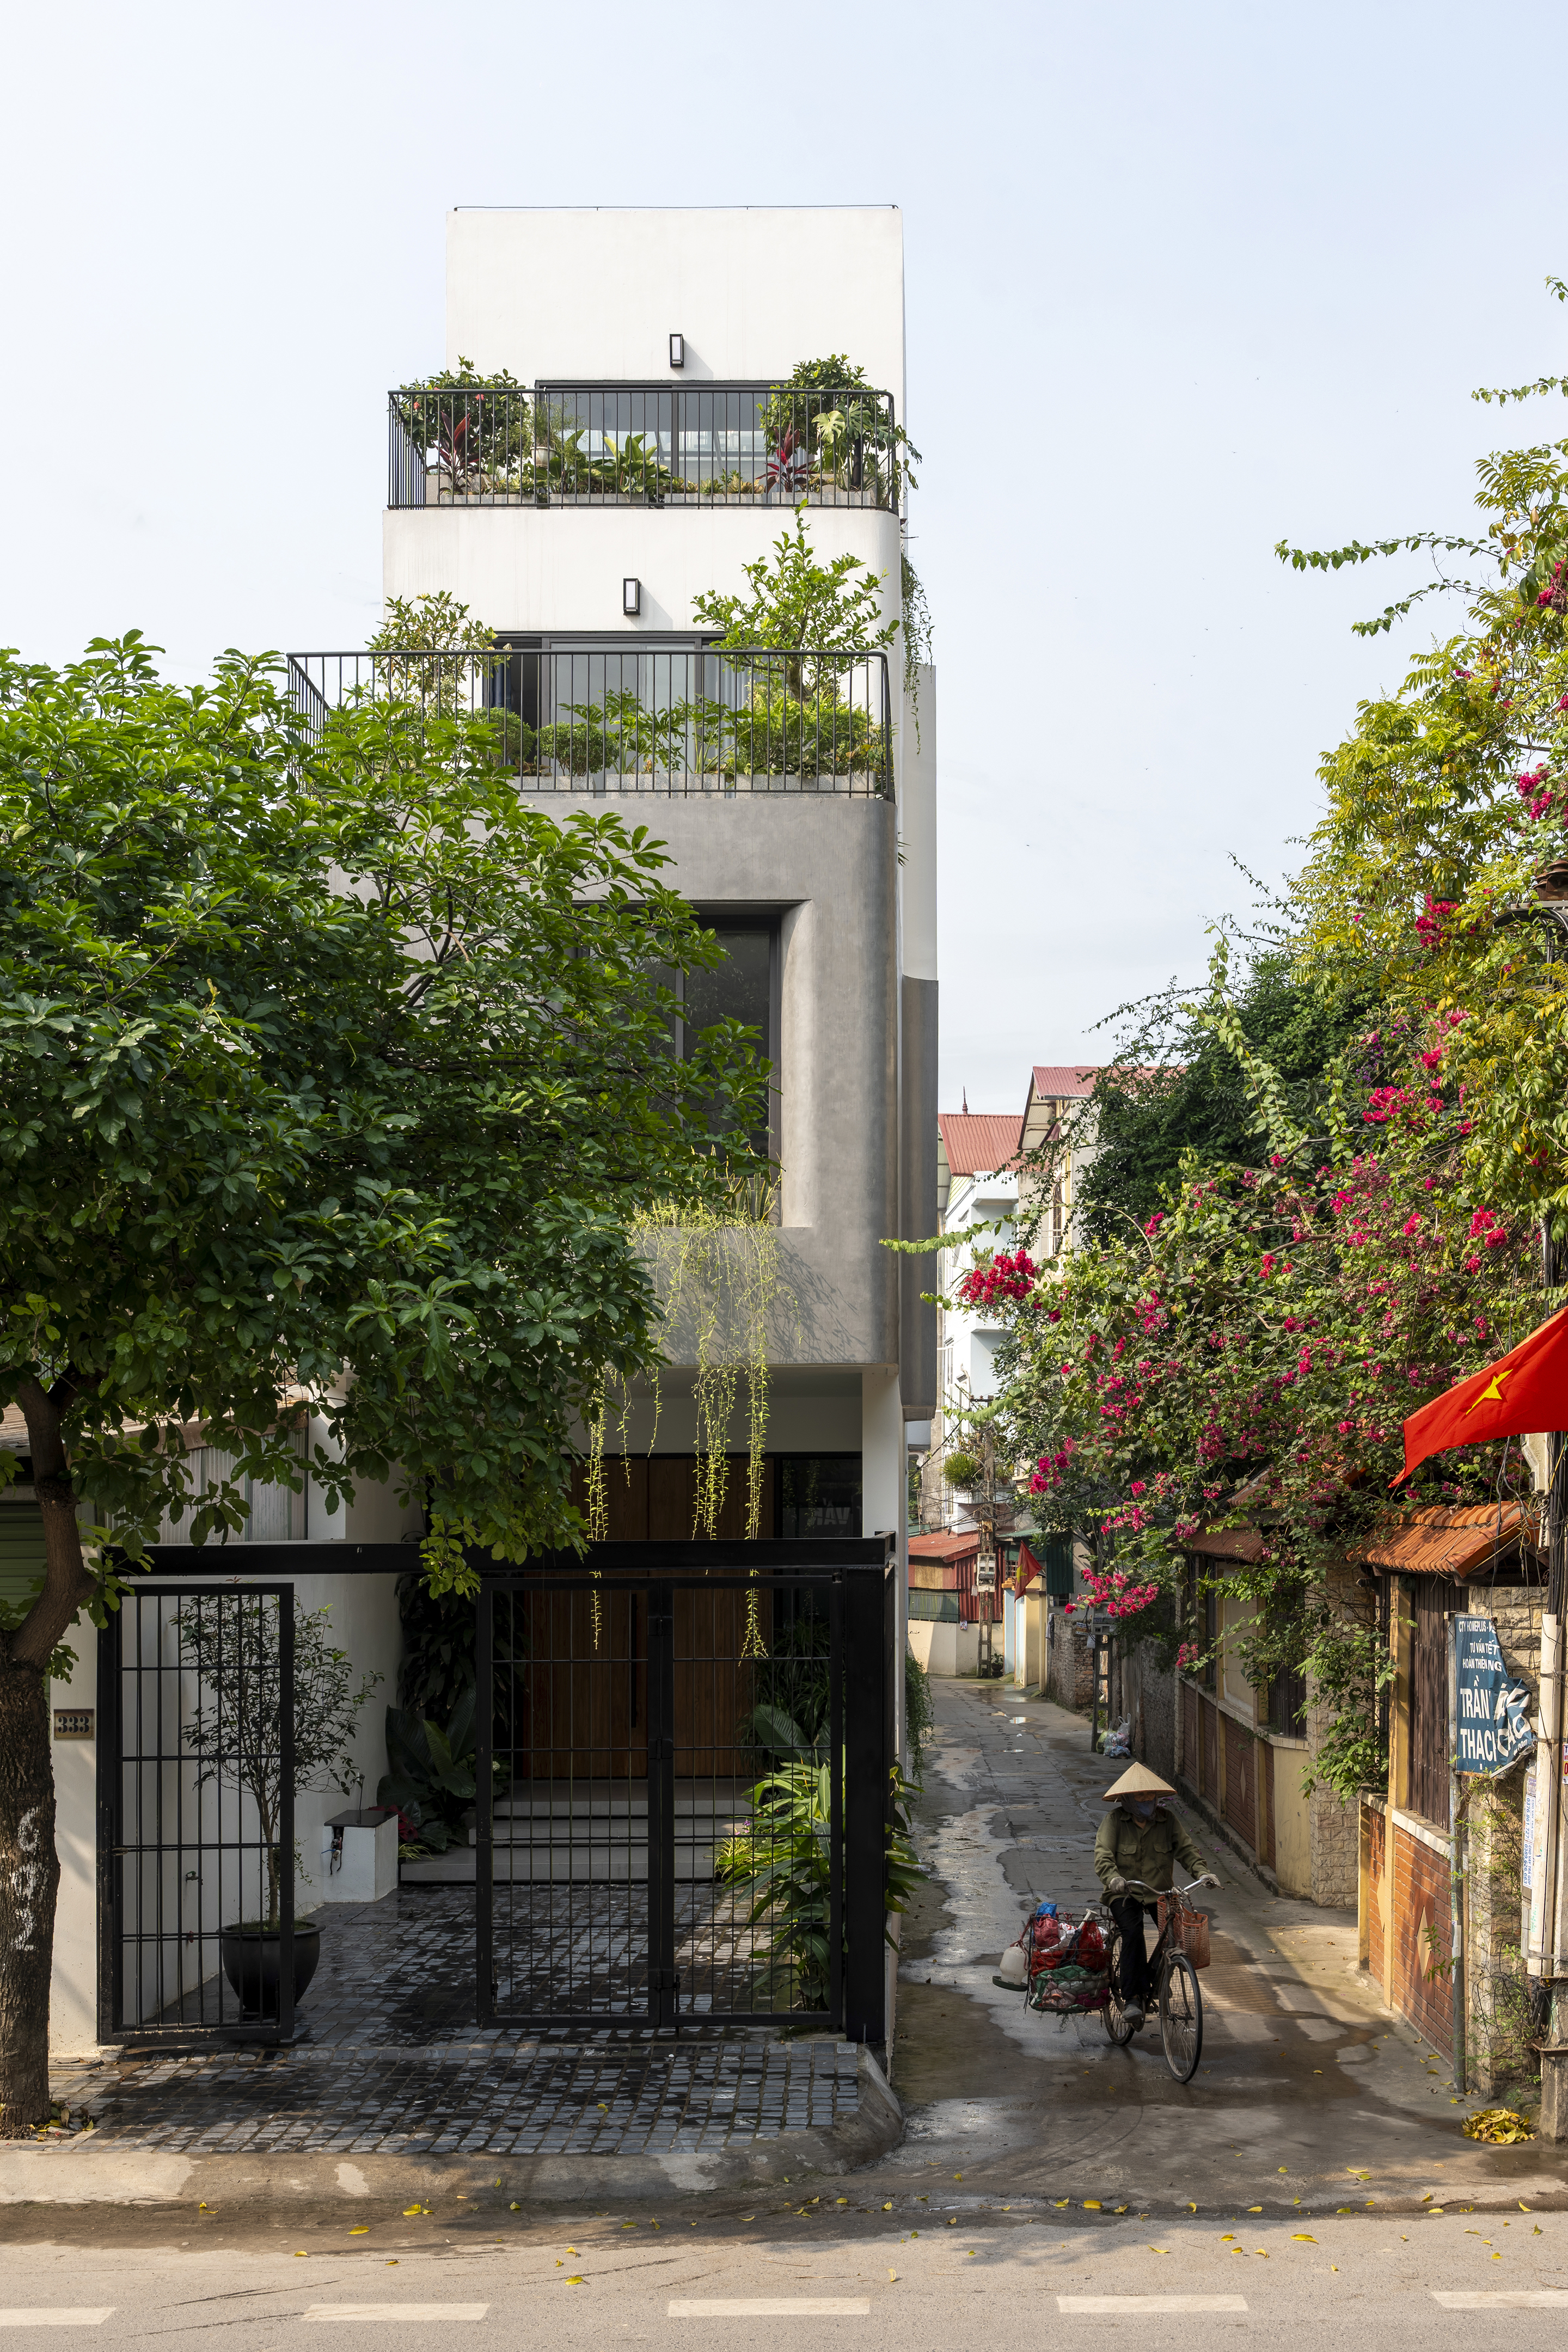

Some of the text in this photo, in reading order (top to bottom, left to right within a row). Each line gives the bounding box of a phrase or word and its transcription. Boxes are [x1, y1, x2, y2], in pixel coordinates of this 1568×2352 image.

[1467, 1621, 1486, 1632] HOMEPLUS
[1469, 1641, 1475, 1653] TƯ
[1476, 1638, 1485, 1653] VẤN
[1462, 1656, 1475, 1669] HOÀN
[1460, 1675, 1490, 1719] TRẦN
[58, 1716, 90, 1733] 333
